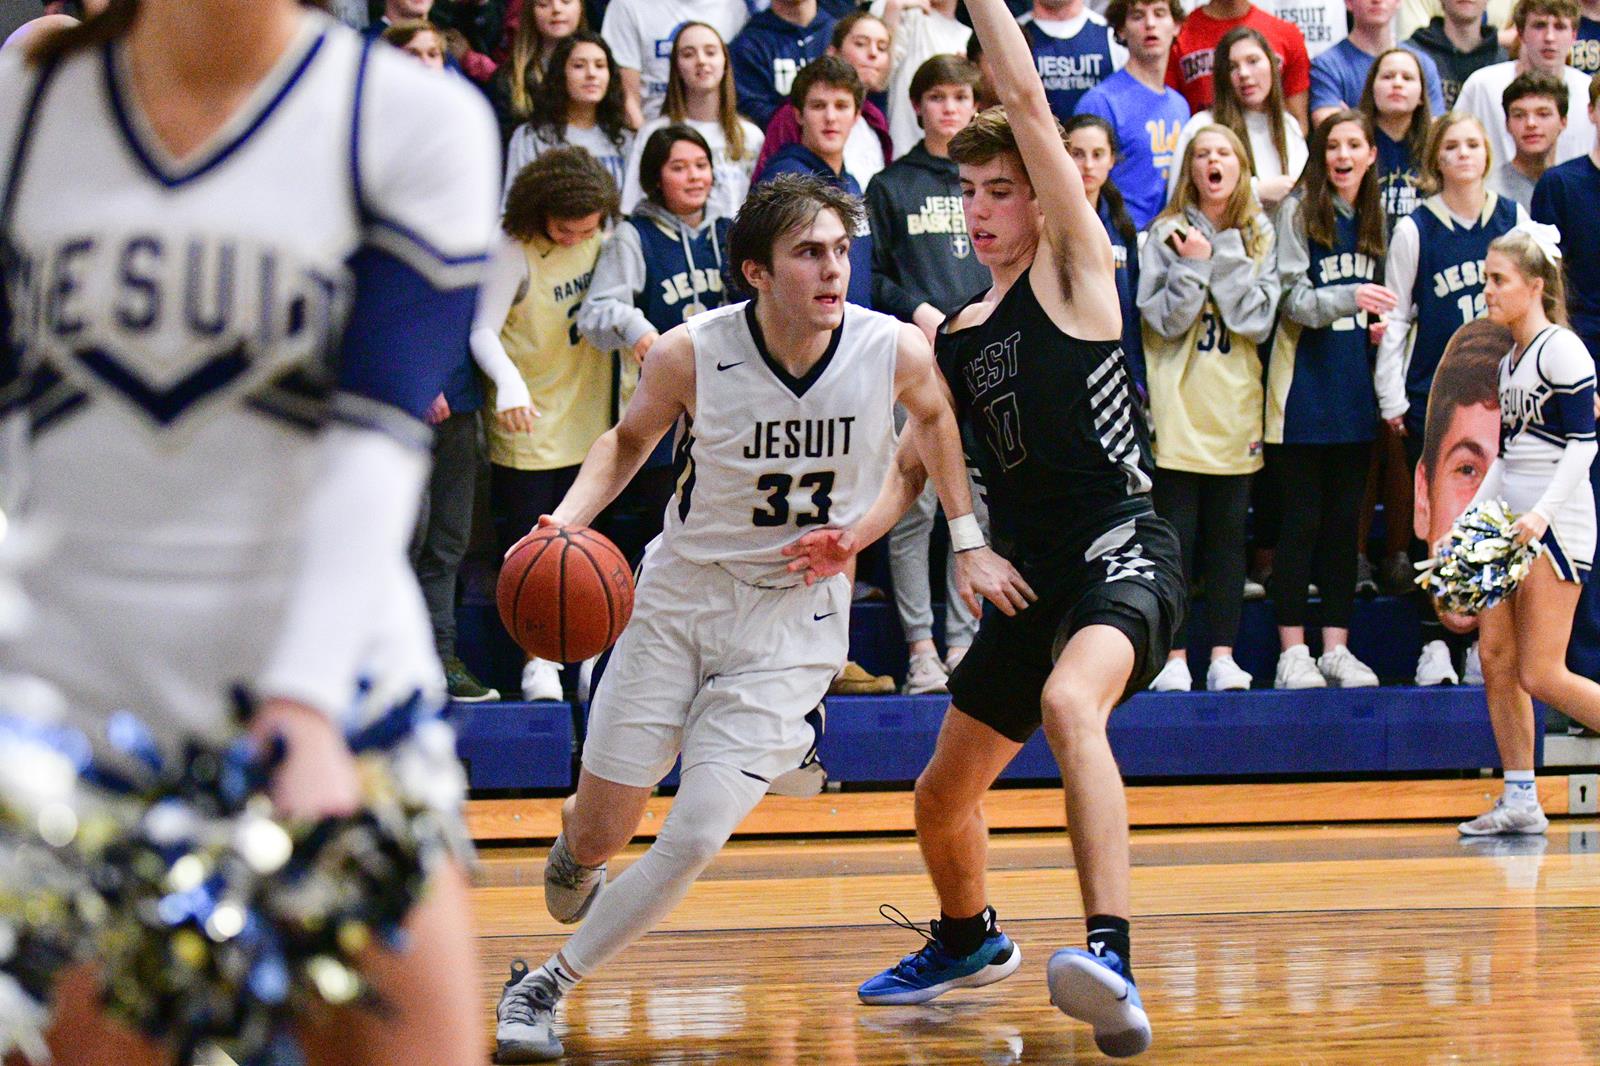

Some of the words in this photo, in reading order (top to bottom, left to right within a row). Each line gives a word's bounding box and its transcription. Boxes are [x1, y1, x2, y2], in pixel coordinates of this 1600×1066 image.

[1302, 25, 1332, 42] ERS
[743, 416, 856, 460] JESUIT
[752, 470, 836, 528] 33
